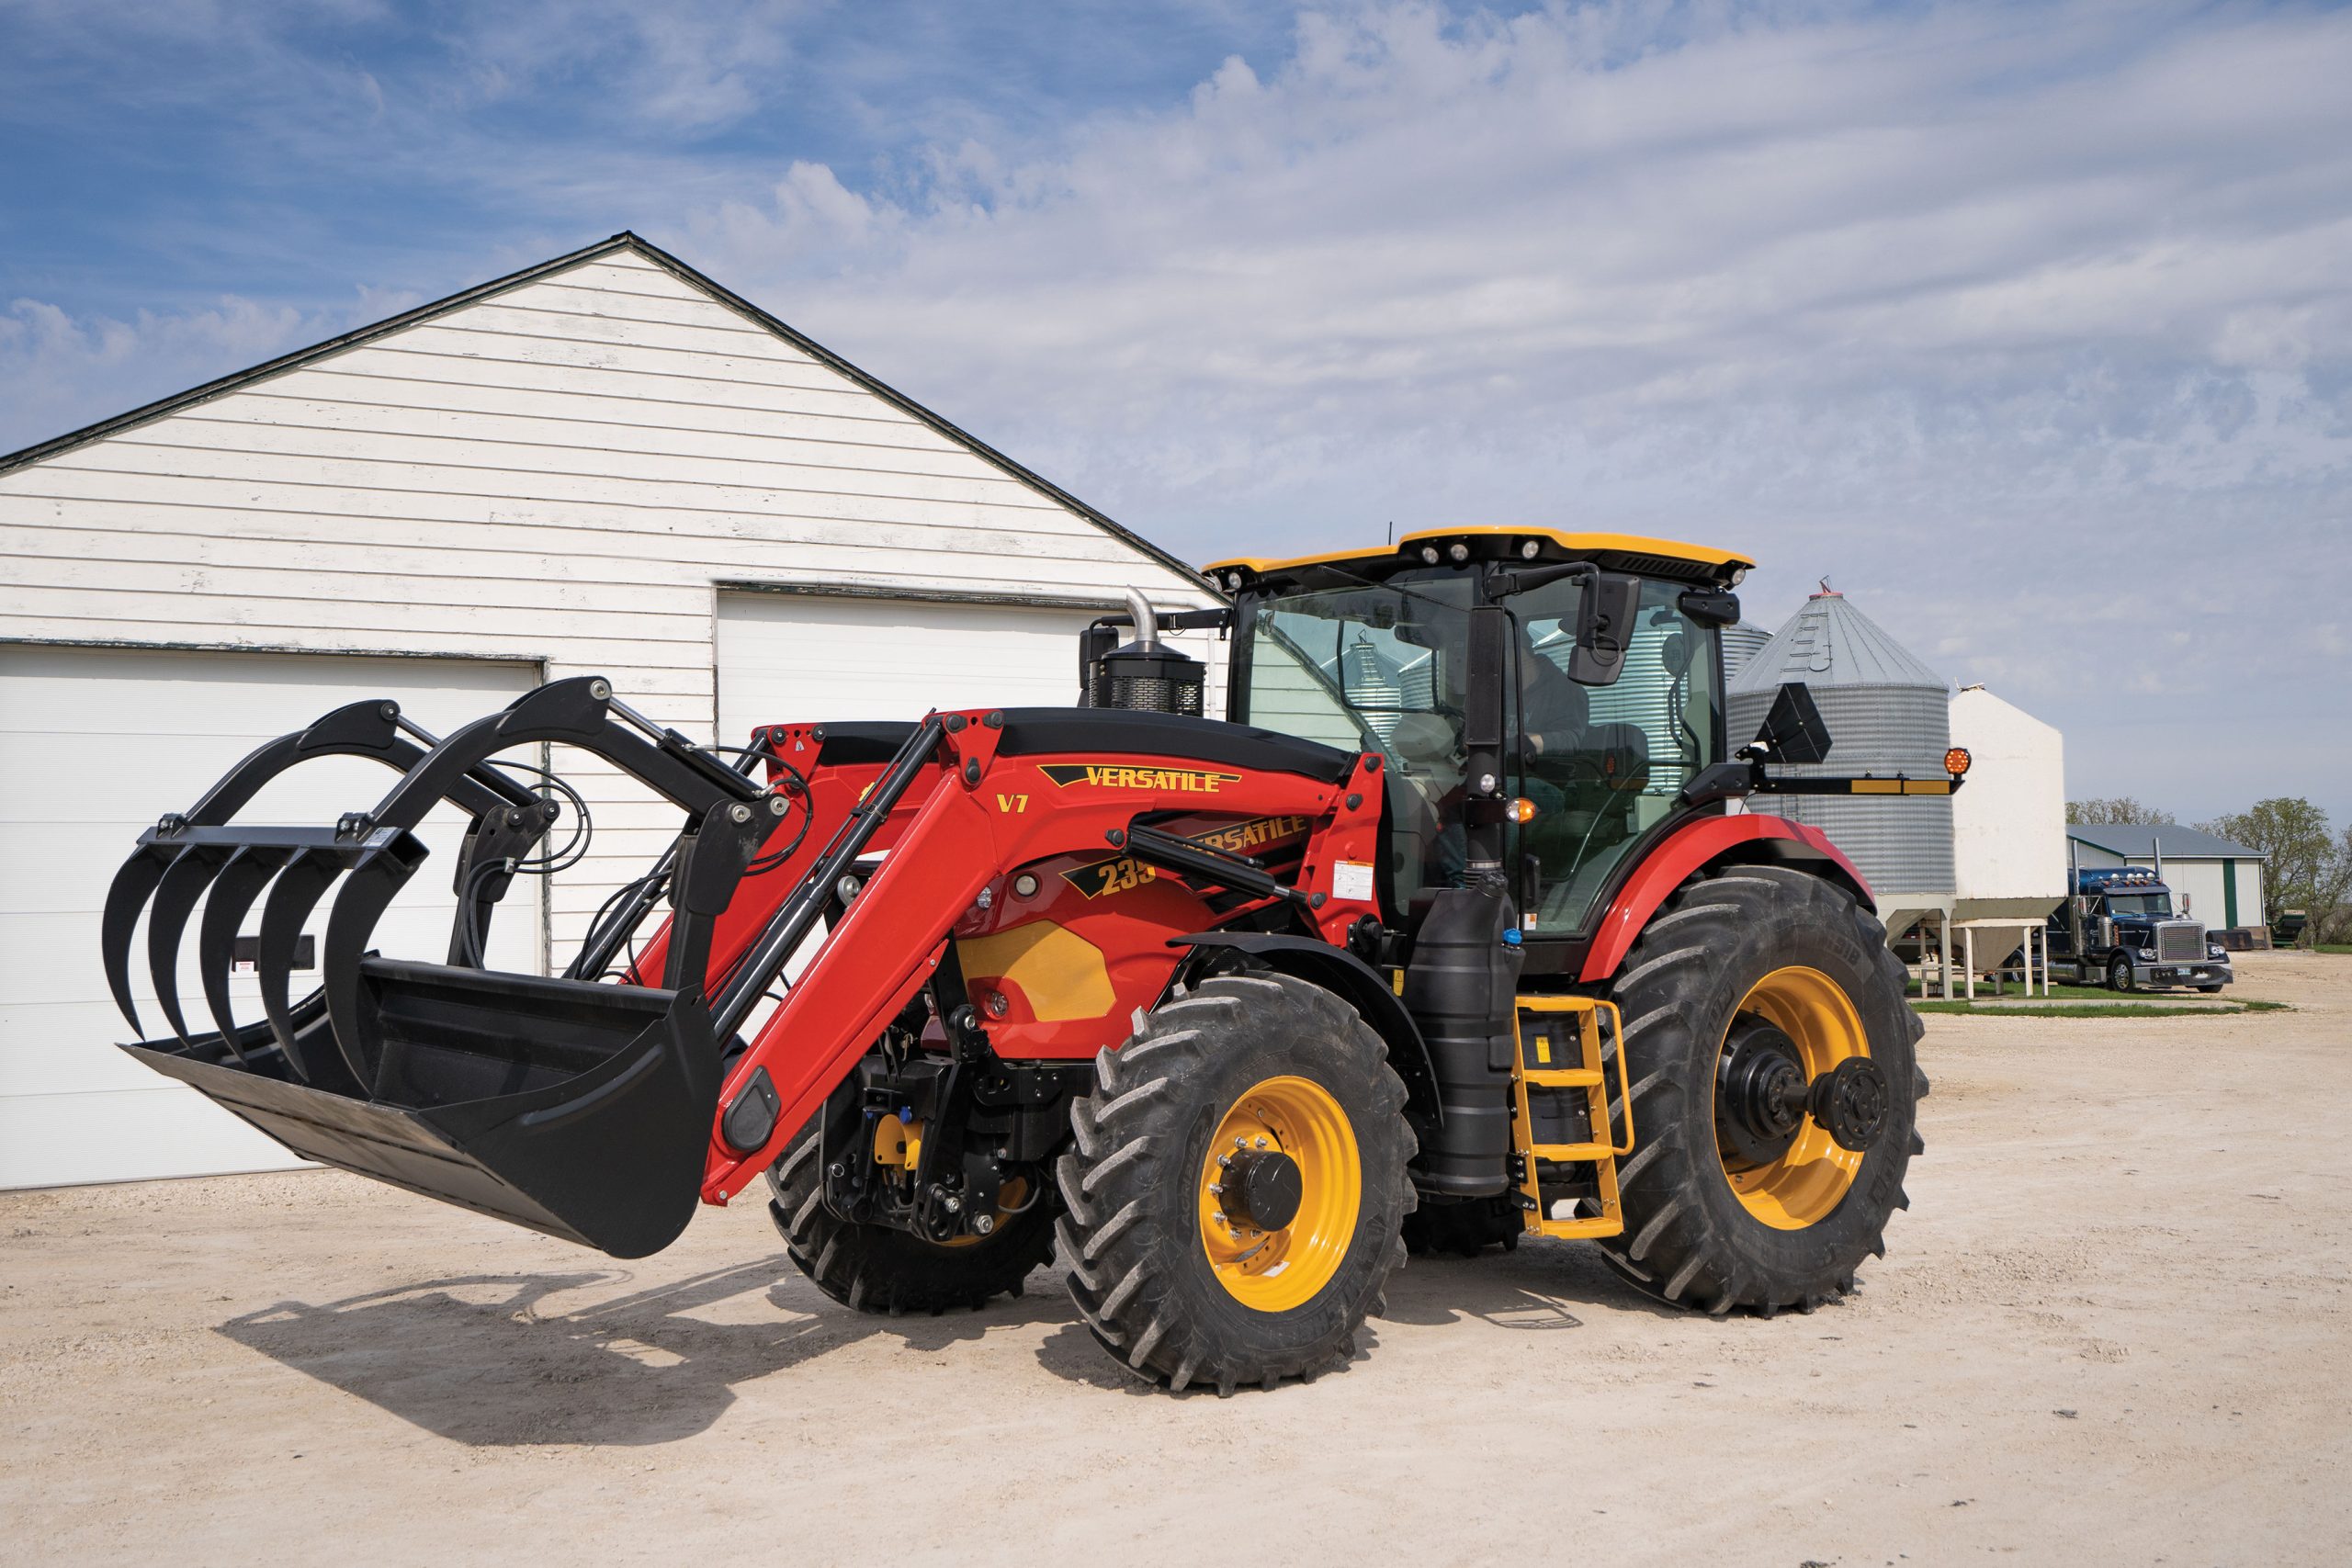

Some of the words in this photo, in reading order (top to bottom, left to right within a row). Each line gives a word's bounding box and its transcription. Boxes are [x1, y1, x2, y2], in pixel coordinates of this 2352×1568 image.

[1086, 766, 1220, 793] VERSATILE
[996, 794, 1029, 813] V7
[1183, 816, 1306, 856] RSATILE
[1099, 859, 1156, 896] 235
